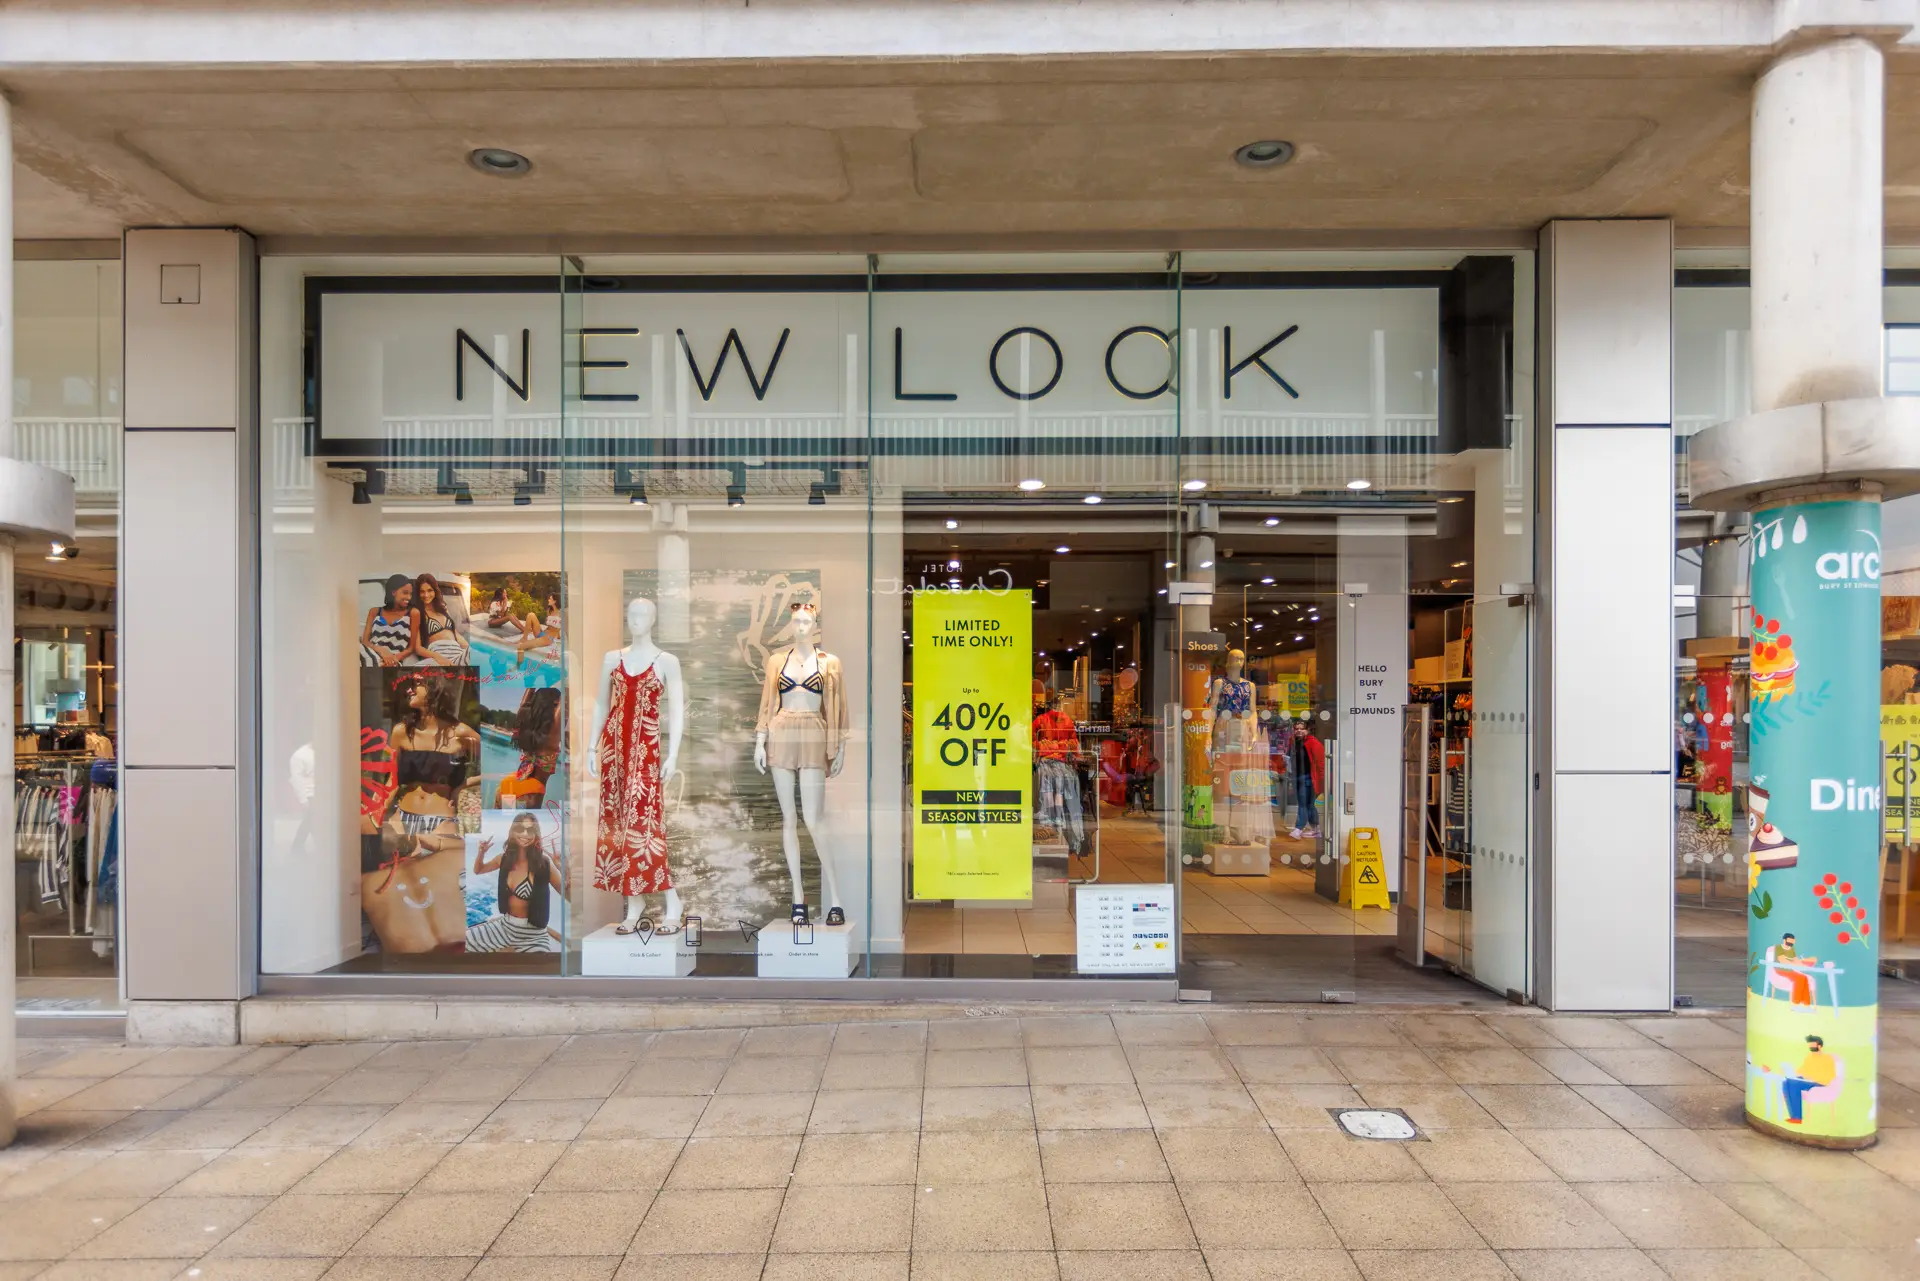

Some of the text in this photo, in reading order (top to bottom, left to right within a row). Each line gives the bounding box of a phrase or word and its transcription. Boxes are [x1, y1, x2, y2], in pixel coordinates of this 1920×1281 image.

[457, 325, 1299, 401] NEW LOOK
[1815, 552, 1880, 580] arc
[945, 619, 1000, 631] LIMITED
[932, 635, 1013, 647] TIME ONLY!
[1188, 641, 1218, 651] Shoes
[1358, 665, 1387, 673] HELLO
[1359, 679, 1384, 687] BURY
[1366, 692, 1377, 700] ST
[931, 702, 1011, 731] 40%
[1349, 707, 1396, 715] EDMUNDS
[940, 738, 1006, 766] OFF
[956, 791, 985, 802] NEW
[928, 811, 1018, 822] SEASON STYLES
